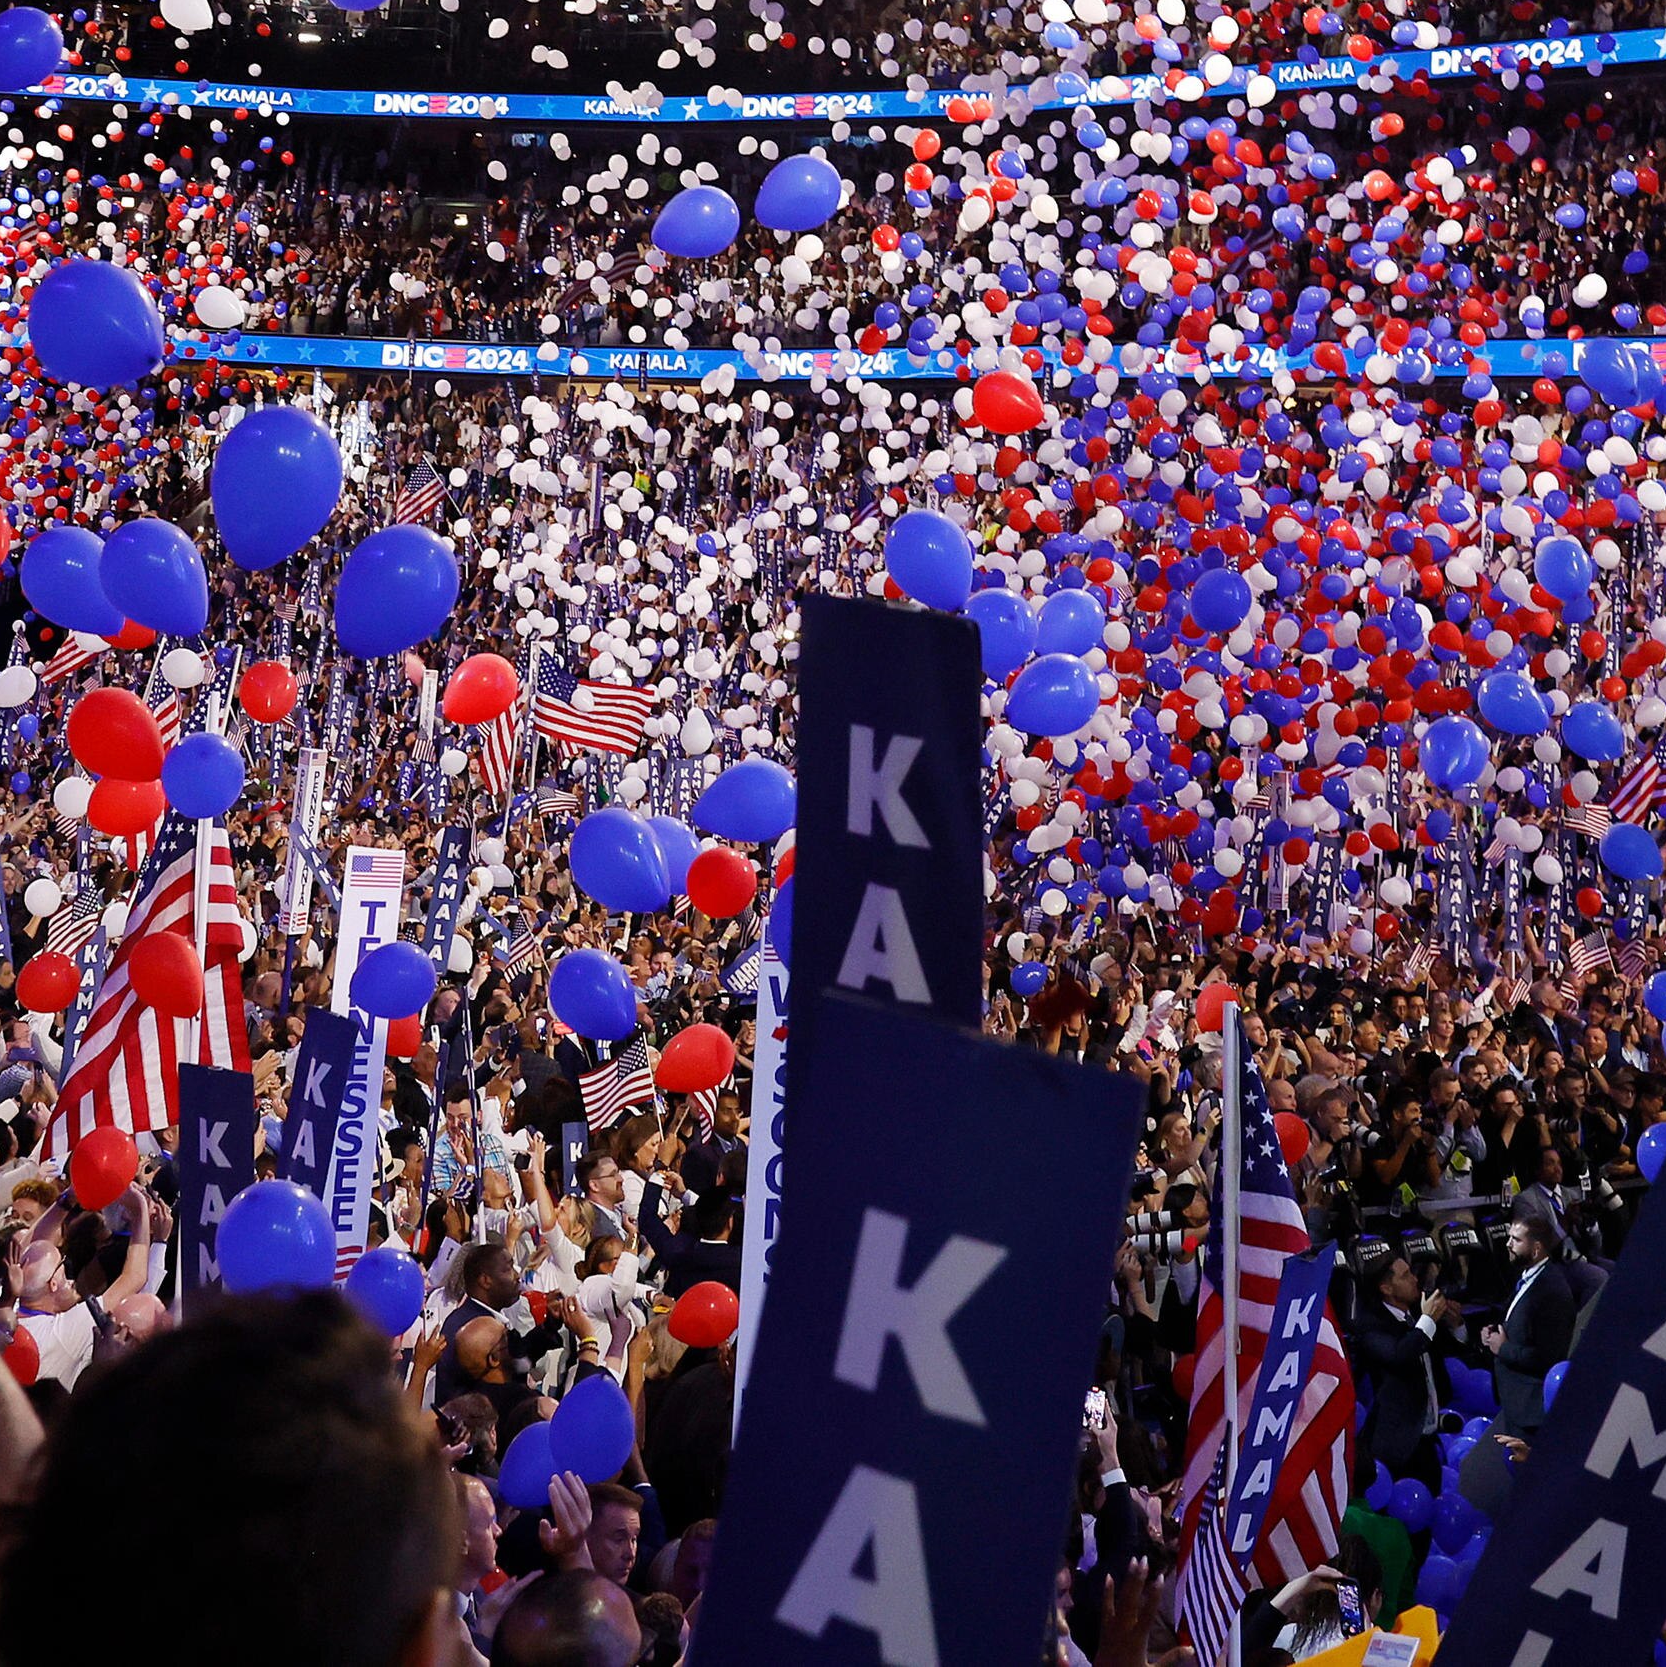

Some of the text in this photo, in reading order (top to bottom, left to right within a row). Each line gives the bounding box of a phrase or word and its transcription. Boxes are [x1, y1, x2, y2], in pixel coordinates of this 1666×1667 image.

[214, 87, 293, 108] KAMALA
[374, 92, 509, 116] DNC 204
[1279, 59, 1356, 84] KAMALA
[743, 96, 795, 118] DNC
[466, 347, 529, 371] 2024
[609, 753, 623, 804] AMALA
[1390, 746, 1400, 806] AMALA
[428, 842, 464, 962] KAMALA
[1311, 846, 1335, 926] KAMALA
[1449, 849, 1463, 933] KAMALA
[1508, 858, 1520, 943] KAMALA
[1548, 884, 1561, 952] AMALA
[334, 900, 387, 1232] TENESSEE
[773, 1206, 1008, 1667] KA
[1228, 1297, 1312, 1554] KAMAL
